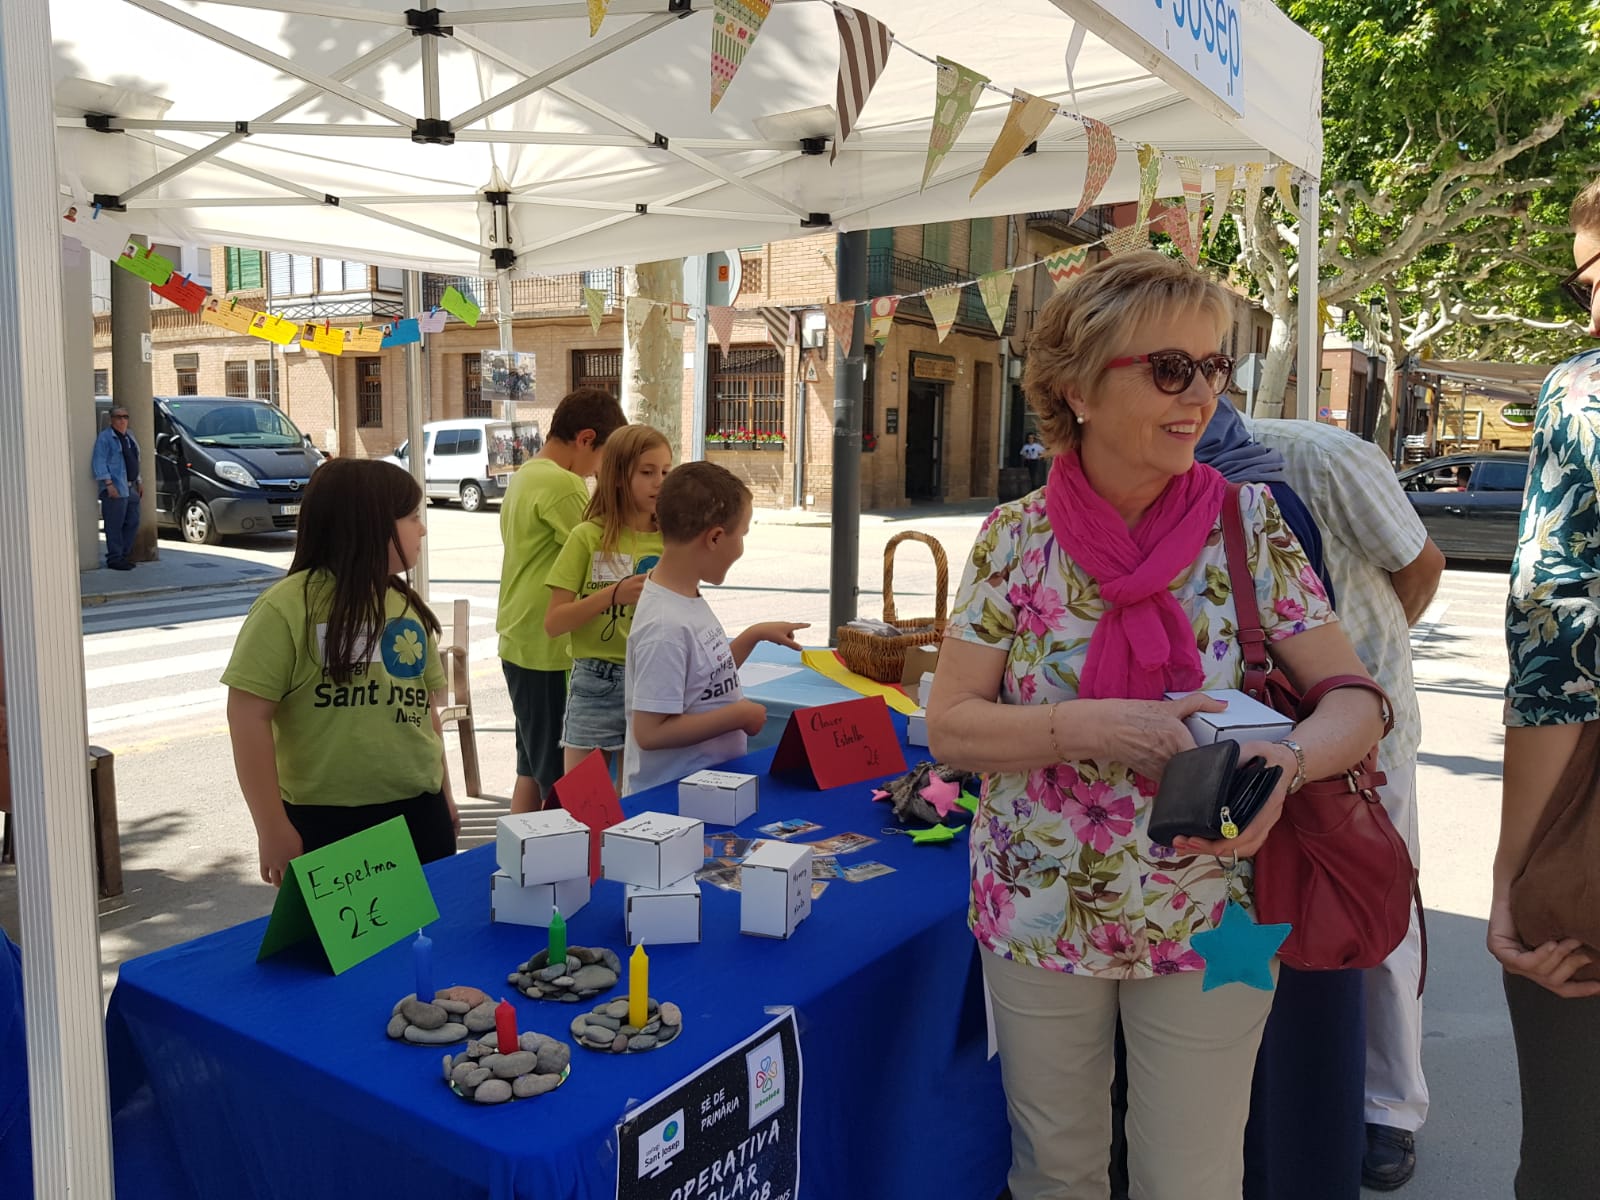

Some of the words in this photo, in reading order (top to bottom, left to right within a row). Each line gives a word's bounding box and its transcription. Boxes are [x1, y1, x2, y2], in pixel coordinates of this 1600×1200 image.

[314, 679, 379, 708] Sant
[700, 671, 739, 701] Sant
[307, 859, 397, 900] Espelma
[339, 897, 388, 939] 2€
[713, 1088, 725, 1104] DE
[644, 1151, 661, 1168] Sant
[661, 1139, 680, 1157] Josep
